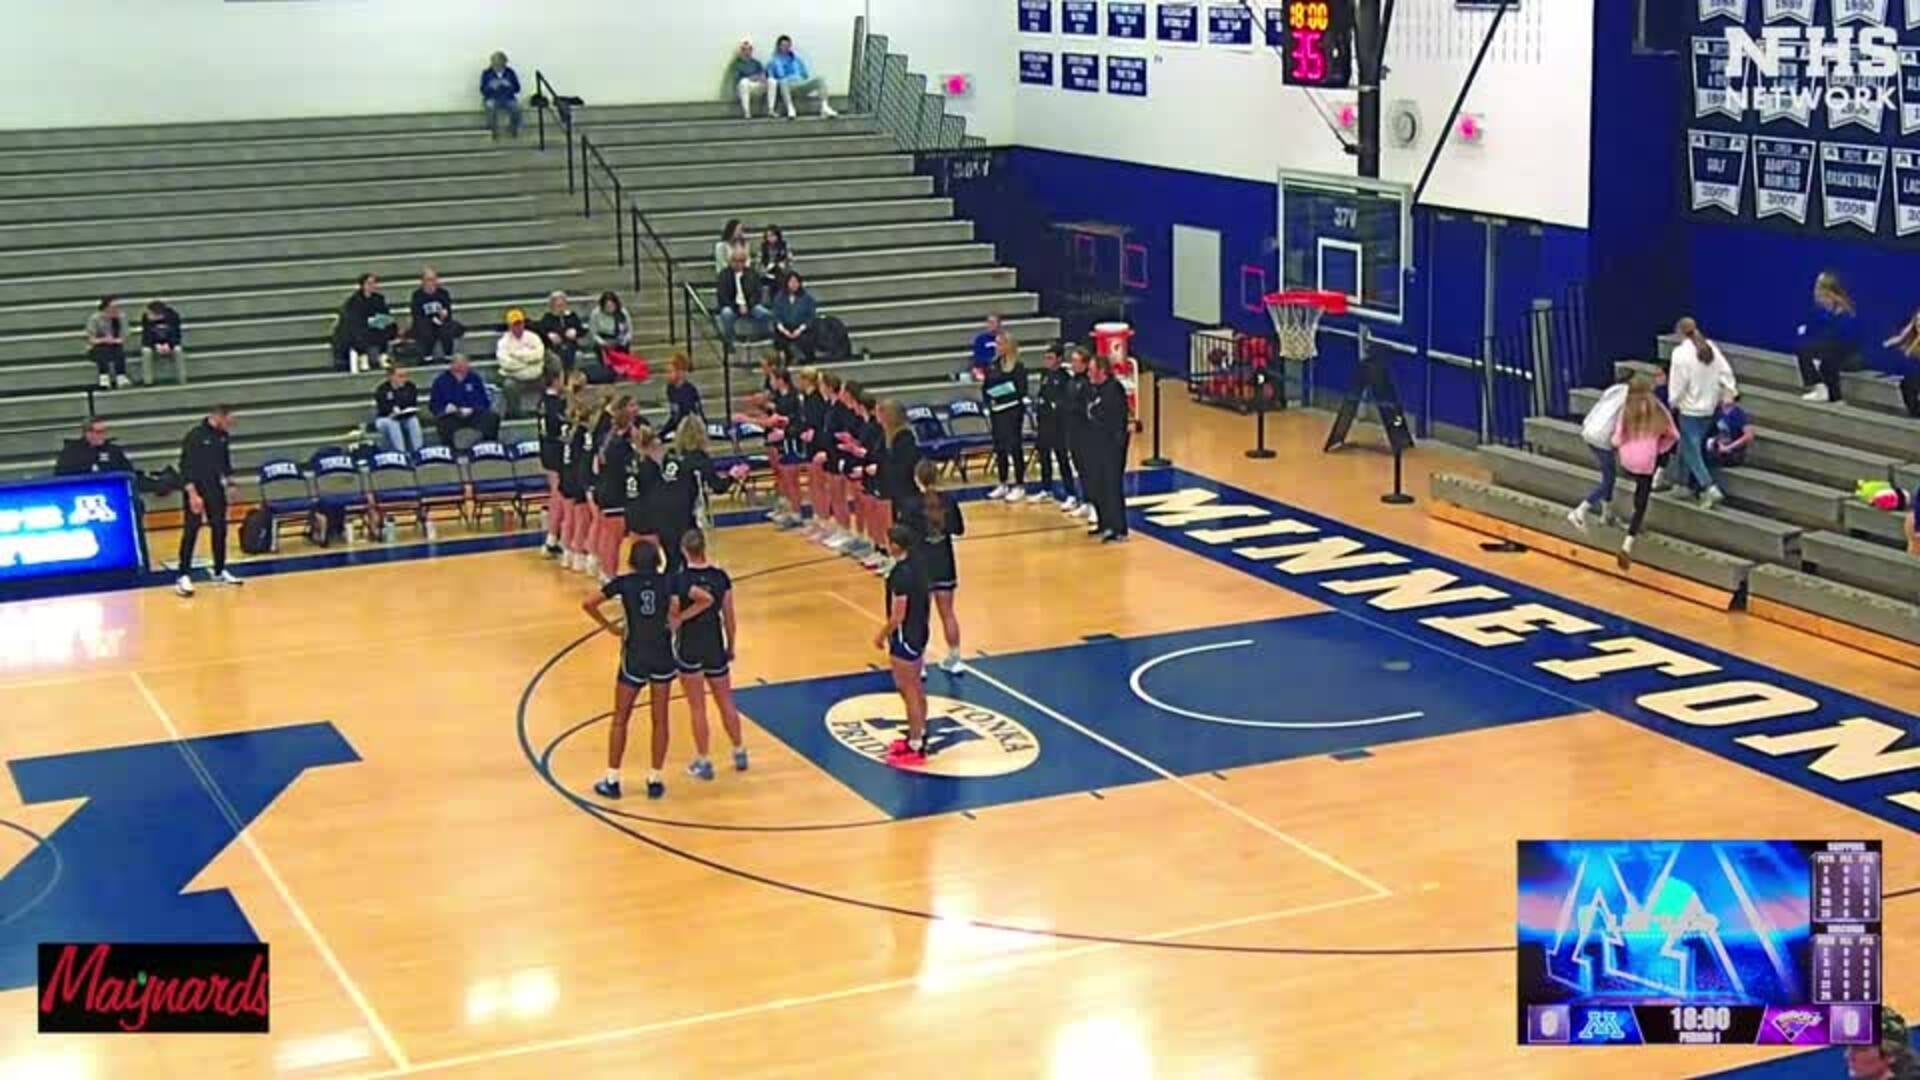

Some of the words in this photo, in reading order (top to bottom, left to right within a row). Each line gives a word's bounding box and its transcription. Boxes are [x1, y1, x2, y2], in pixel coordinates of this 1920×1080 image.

[1291, 31, 1326, 79] 35
[419, 446, 452, 460] TONKA
[472, 443, 505, 457] TONKA
[319, 455, 353, 470] TONKA
[375, 451, 407, 467] TONKA
[263, 462, 297, 478] TONKA
[1123, 487, 1920, 811] MINNETON
[946, 704, 1034, 753] TONKA
[831, 720, 889, 759] PRID
